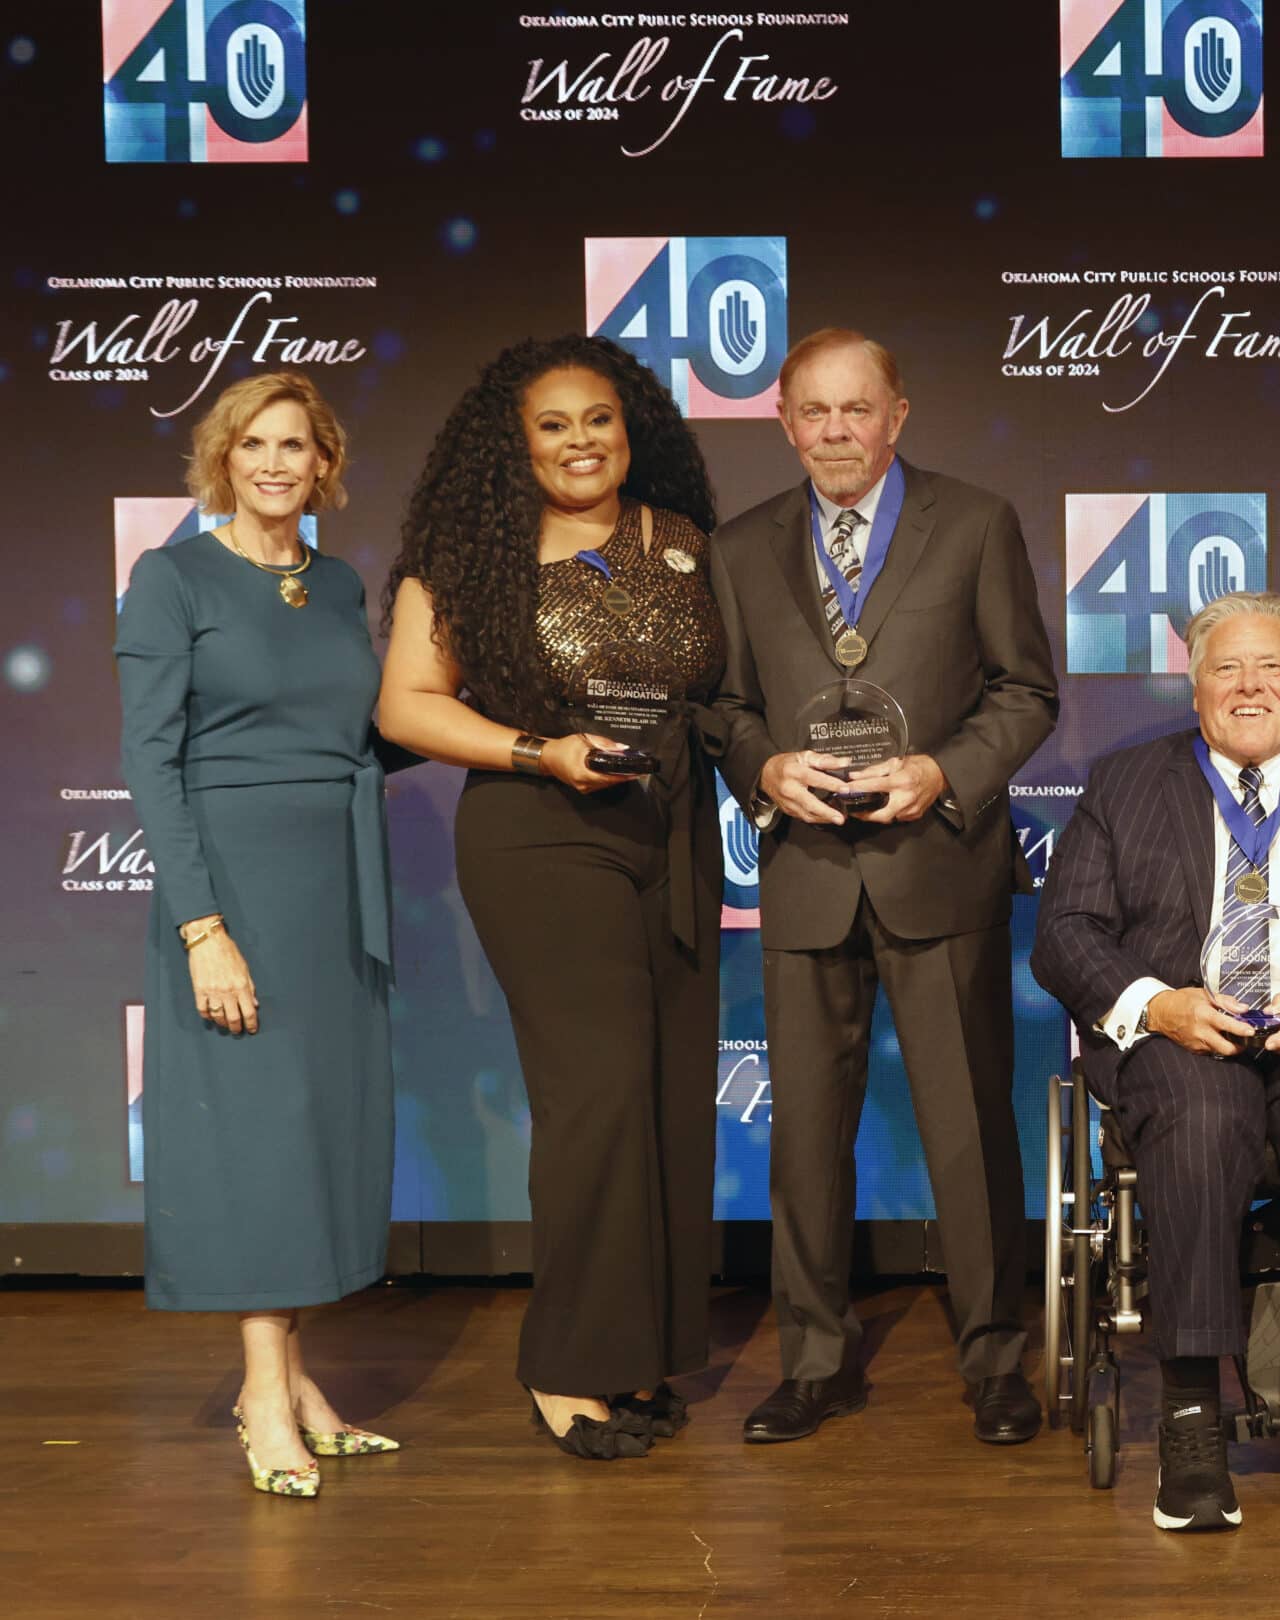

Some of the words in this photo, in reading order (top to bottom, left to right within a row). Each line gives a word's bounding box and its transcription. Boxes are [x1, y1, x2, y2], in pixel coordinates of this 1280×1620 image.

[520, 15, 598, 27] OKLAHOMA
[601, 14, 634, 27] CITY
[638, 14, 686, 26] PUBLIC
[690, 13, 753, 26] SCHOOLS
[757, 13, 849, 25] FOUNDATION
[521, 37, 669, 103] Wall
[621, 29, 743, 157] of
[724, 54, 838, 102] Fame
[520, 108, 561, 120] CLASS
[564, 108, 583, 120] OF
[587, 108, 619, 120] 2024
[48, 277, 128, 288] OKLAHOMA
[129, 276, 163, 288] CITY
[166, 276, 214, 288] PUBLIC
[218, 276, 281, 288] SCHOOLS
[285, 276, 376, 287] FOUNDATION
[1002, 271, 1080, 283] OKLAHOMA
[1084, 270, 1116, 283] CITY
[1120, 270, 1167, 283] PUBLIC
[1172, 270, 1235, 283] SCHOOLS
[50, 299, 199, 364] Wall
[150, 291, 272, 418] of
[252, 317, 366, 363] Fame
[1003, 293, 1151, 360] Wall
[1102, 286, 1225, 413] of
[49, 370, 91, 381] CLASS
[94, 370, 113, 381] OF
[115, 369, 148, 381] 2024
[1002, 364, 1042, 376] CLASS
[1046, 364, 1064, 376] OF
[1068, 364, 1100, 376] 2024
[606, 688, 668, 700] FOUNDATION
[830, 725, 889, 738] FOUNDATION
[60, 788, 133, 800] OKLAHOM
[62, 828, 156, 875] Wa
[62, 879, 104, 891] CLASS
[105, 880, 127, 891] OF
[128, 879, 154, 891] 202
[718, 1040, 768, 1051] HOOLS
